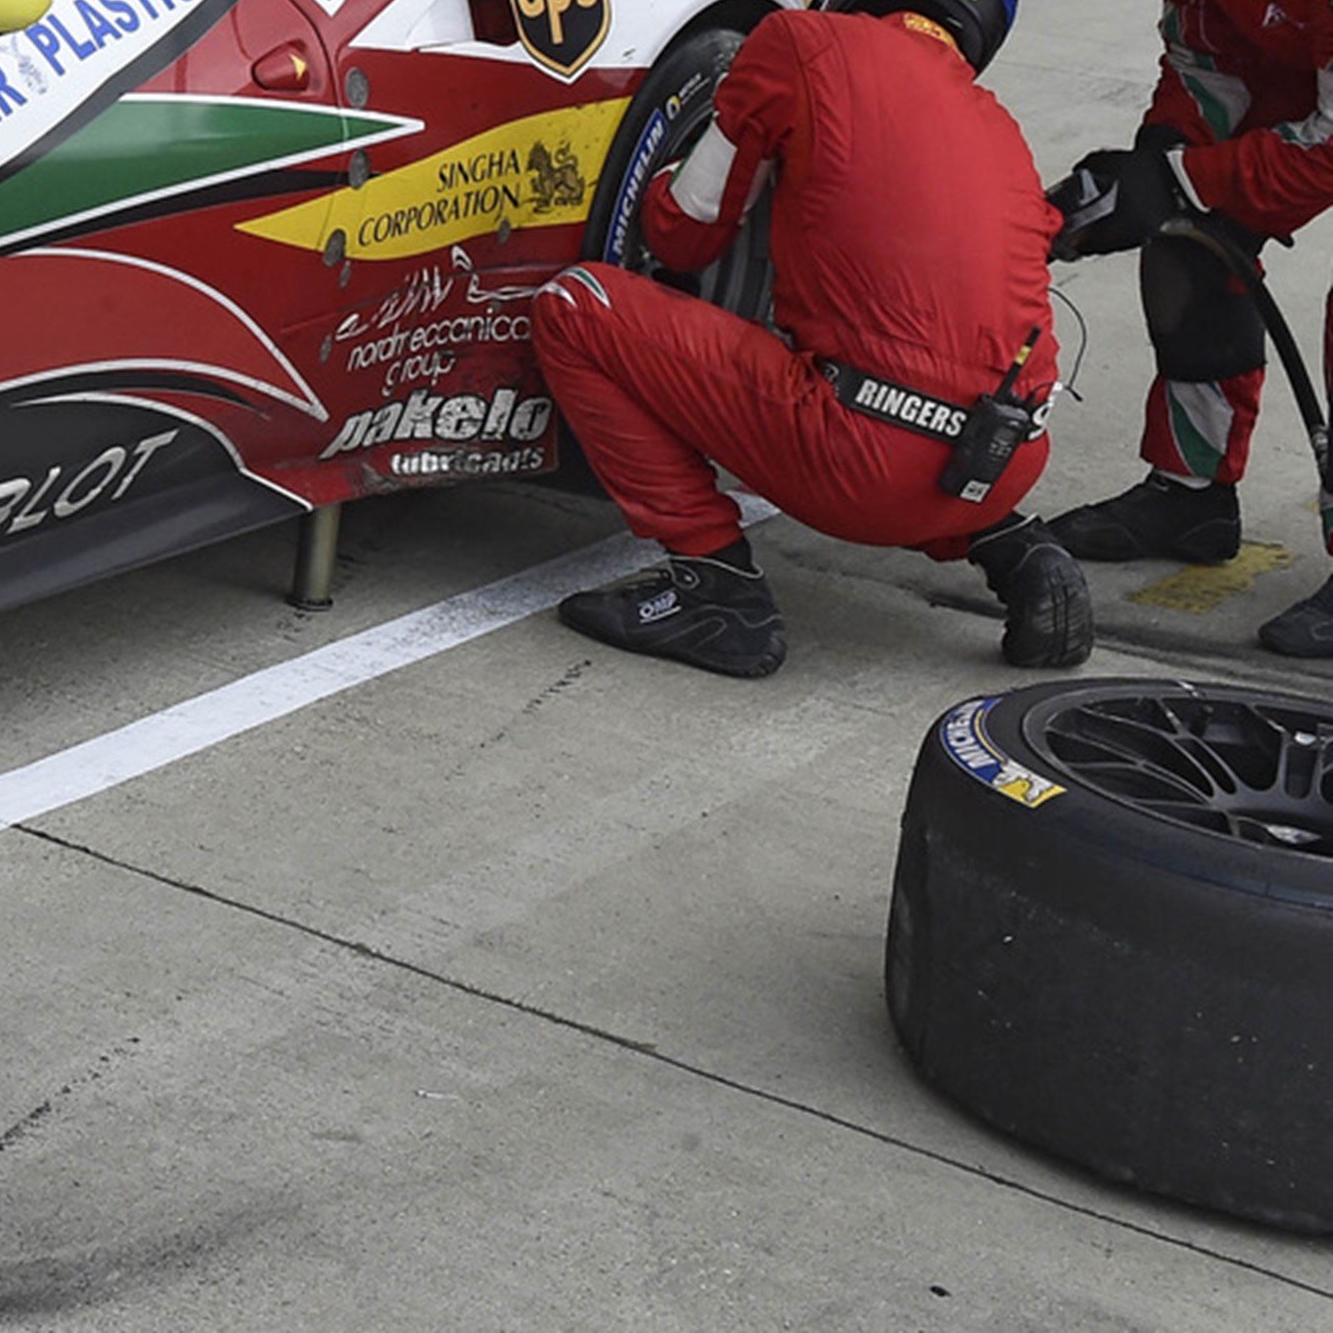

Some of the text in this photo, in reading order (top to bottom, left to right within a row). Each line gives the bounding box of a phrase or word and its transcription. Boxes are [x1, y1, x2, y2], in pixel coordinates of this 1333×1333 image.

[435, 148, 521, 194] SINGHA
[612, 120, 664, 255] MICHELIN
[358, 185, 520, 247] CORPORATION
[382, 350, 456, 397] group
[319, 388, 553, 460] pakelo
[856, 379, 967, 437] RINGERS
